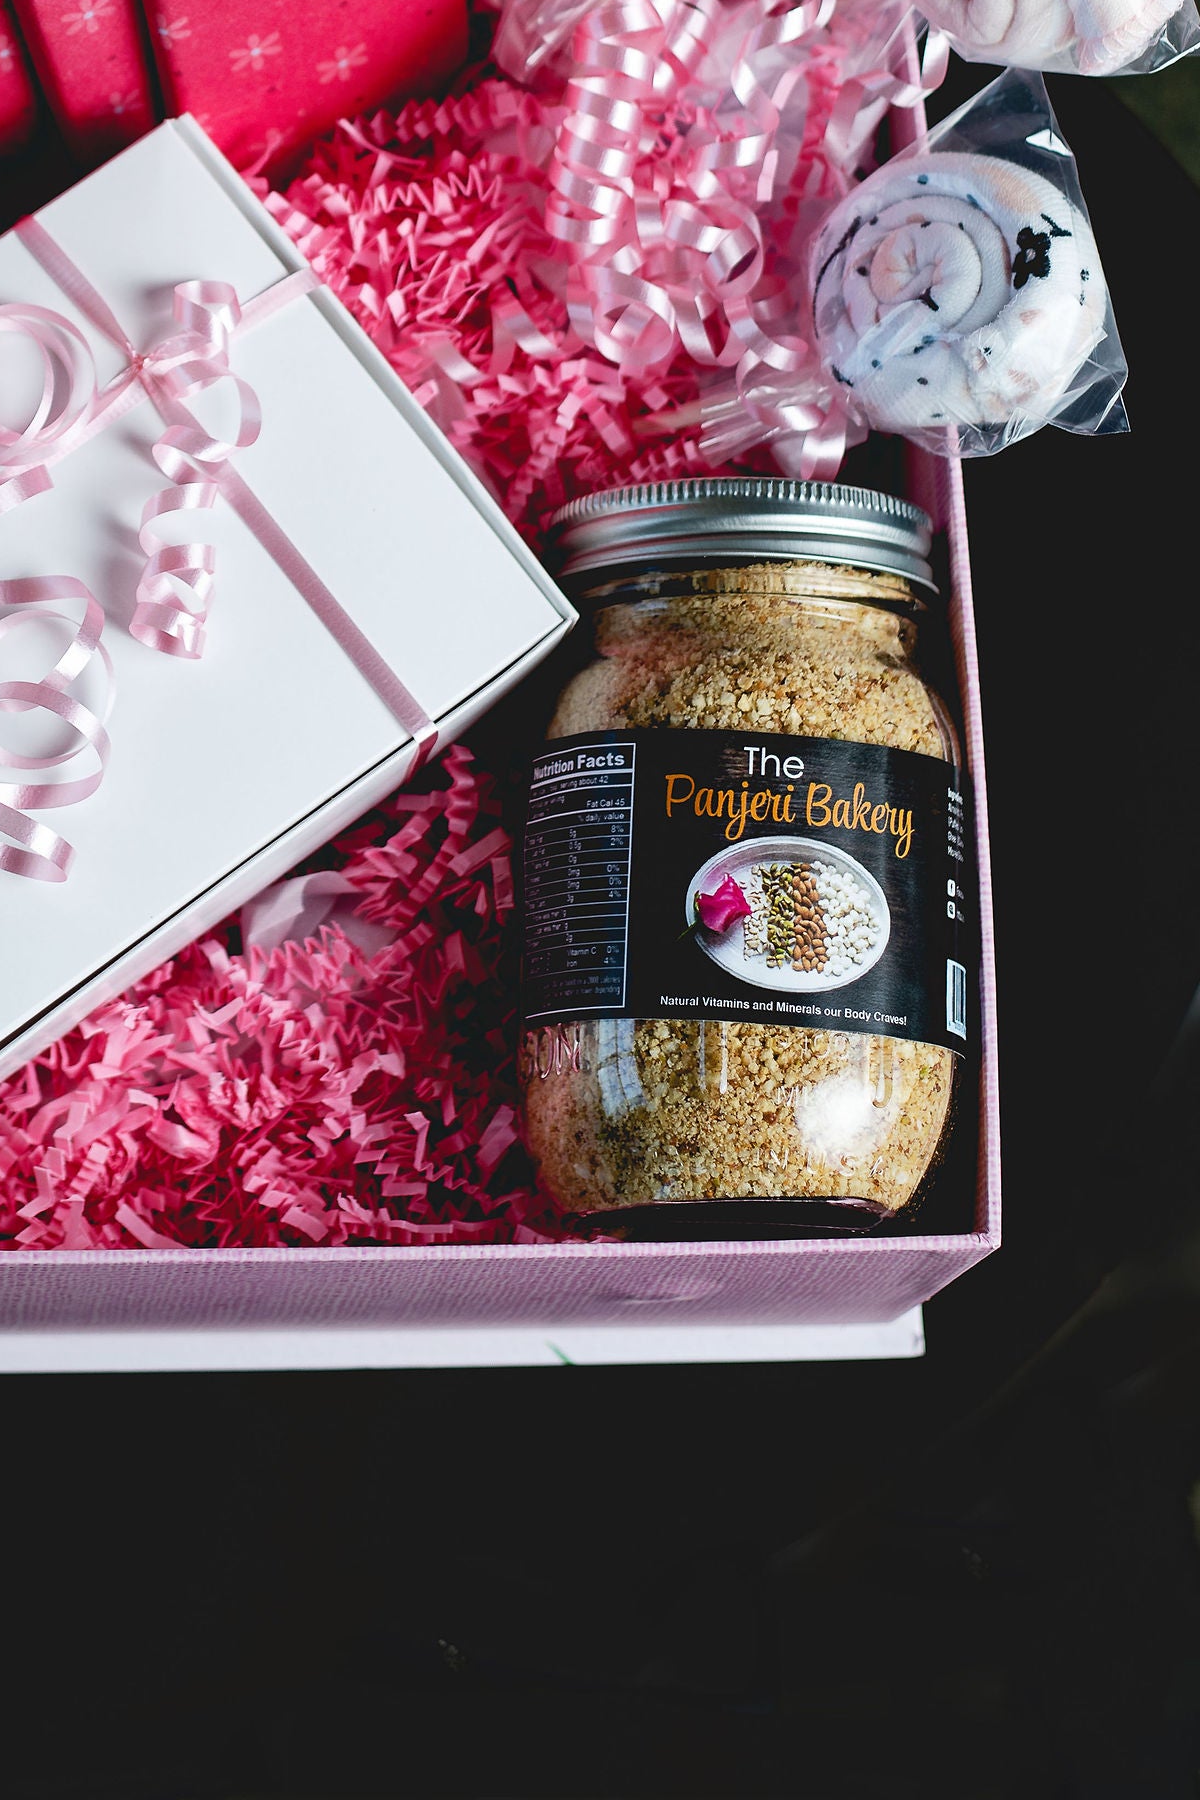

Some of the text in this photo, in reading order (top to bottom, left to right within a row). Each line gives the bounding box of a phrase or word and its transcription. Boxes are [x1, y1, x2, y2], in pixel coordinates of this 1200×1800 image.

[533, 752, 625, 780] Nutrition Facts
[743, 746, 805, 779] The
[600, 798, 614, 808] Cal
[604, 811, 625, 820] value
[665, 773, 915, 859] Panjeri Bakery
[660, 995, 908, 1026] Natural Vitamins and Minerals our Body Craves!
